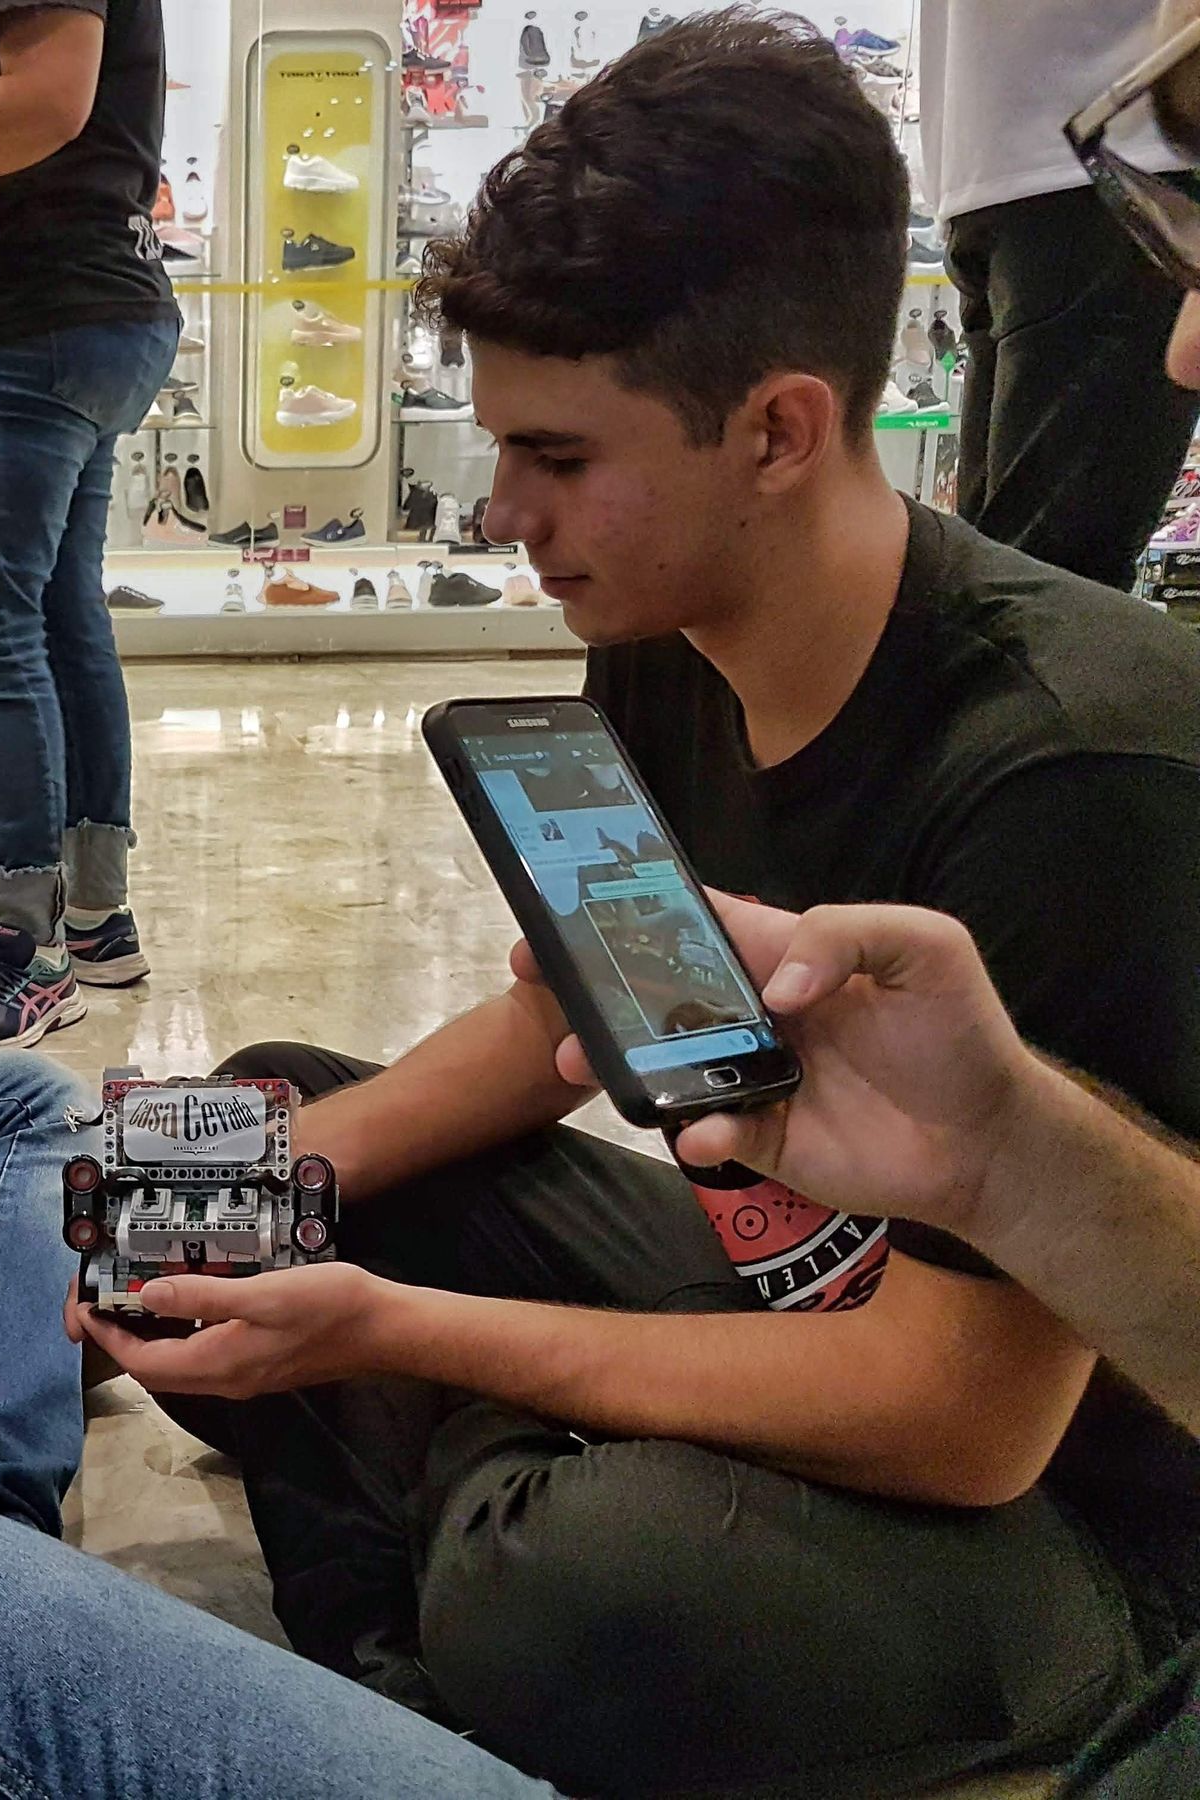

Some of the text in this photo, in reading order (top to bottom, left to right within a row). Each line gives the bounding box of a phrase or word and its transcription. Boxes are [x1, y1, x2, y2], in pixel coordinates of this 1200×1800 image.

[129, 1094, 260, 1142] Casa Cevada
[757, 1221, 863, 1300] ALLEN
